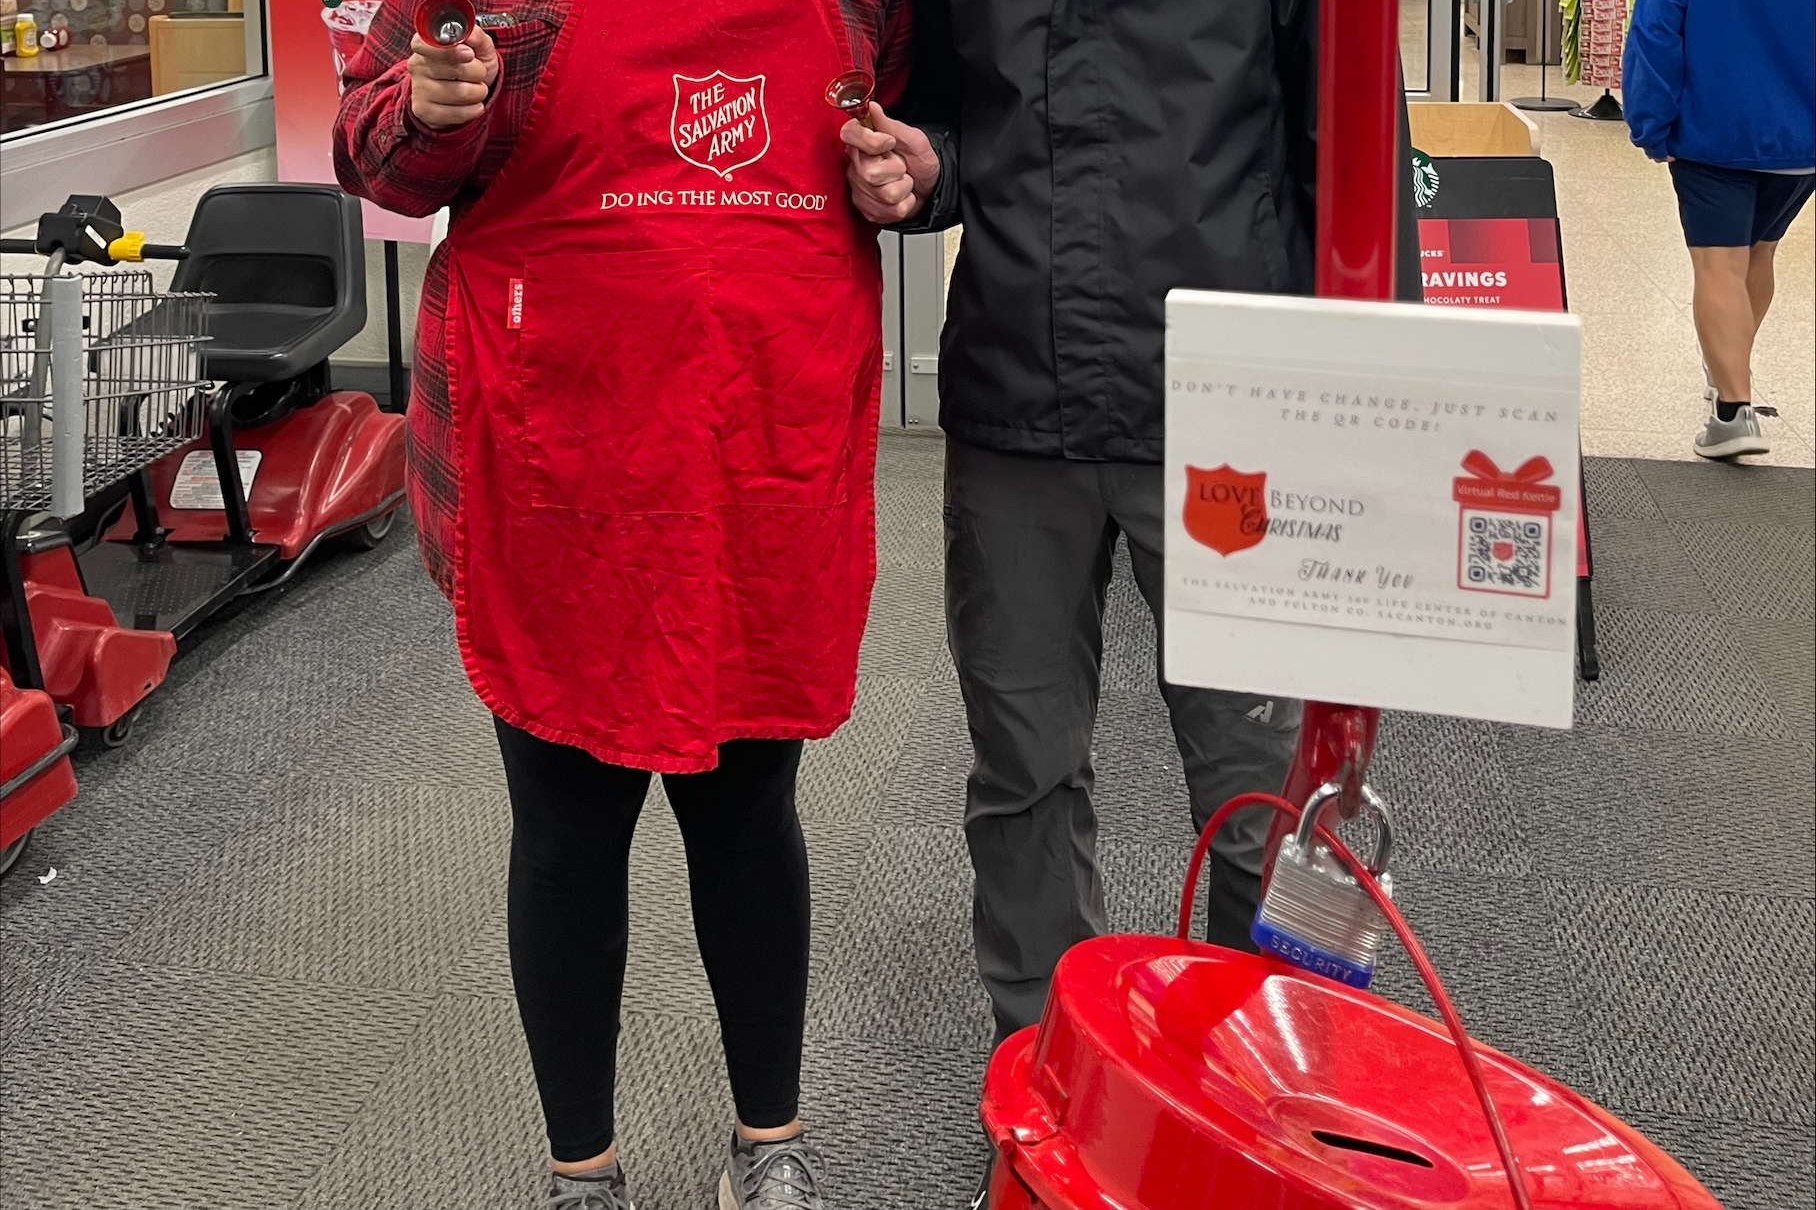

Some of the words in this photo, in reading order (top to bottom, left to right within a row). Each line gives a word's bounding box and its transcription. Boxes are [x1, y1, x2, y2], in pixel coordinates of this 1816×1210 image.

[690, 82, 725, 114] THE
[679, 87, 756, 148] SALVATION
[707, 115, 756, 162] ARMY
[677, 190, 715, 206] THE
[720, 191, 772, 206] MOST
[511, 283, 523, 323] others
[1473, 296, 1500, 304] TREAT
[1250, 387, 1306, 402] HAVE
[1430, 401, 1486, 417] JUST
[1498, 407, 1559, 423] SCAN
[1280, 408, 1321, 422] THE
[1334, 413, 1361, 427] QR
[1199, 482, 1262, 507] LOVE
[1270, 489, 1365, 516] BEYOND
[1456, 485, 1495, 497] Virtual
[1497, 488, 1520, 500] Red
[1181, 576, 1208, 587] THE
[1214, 581, 1295, 597] SALVATION
[1302, 590, 1339, 602] ARMY
[1415, 601, 1471, 616] CENTER
[1504, 611, 1567, 626] CANTON
[1249, 596, 1277, 607] AND
[1271, 934, 1352, 981] SECURITY
